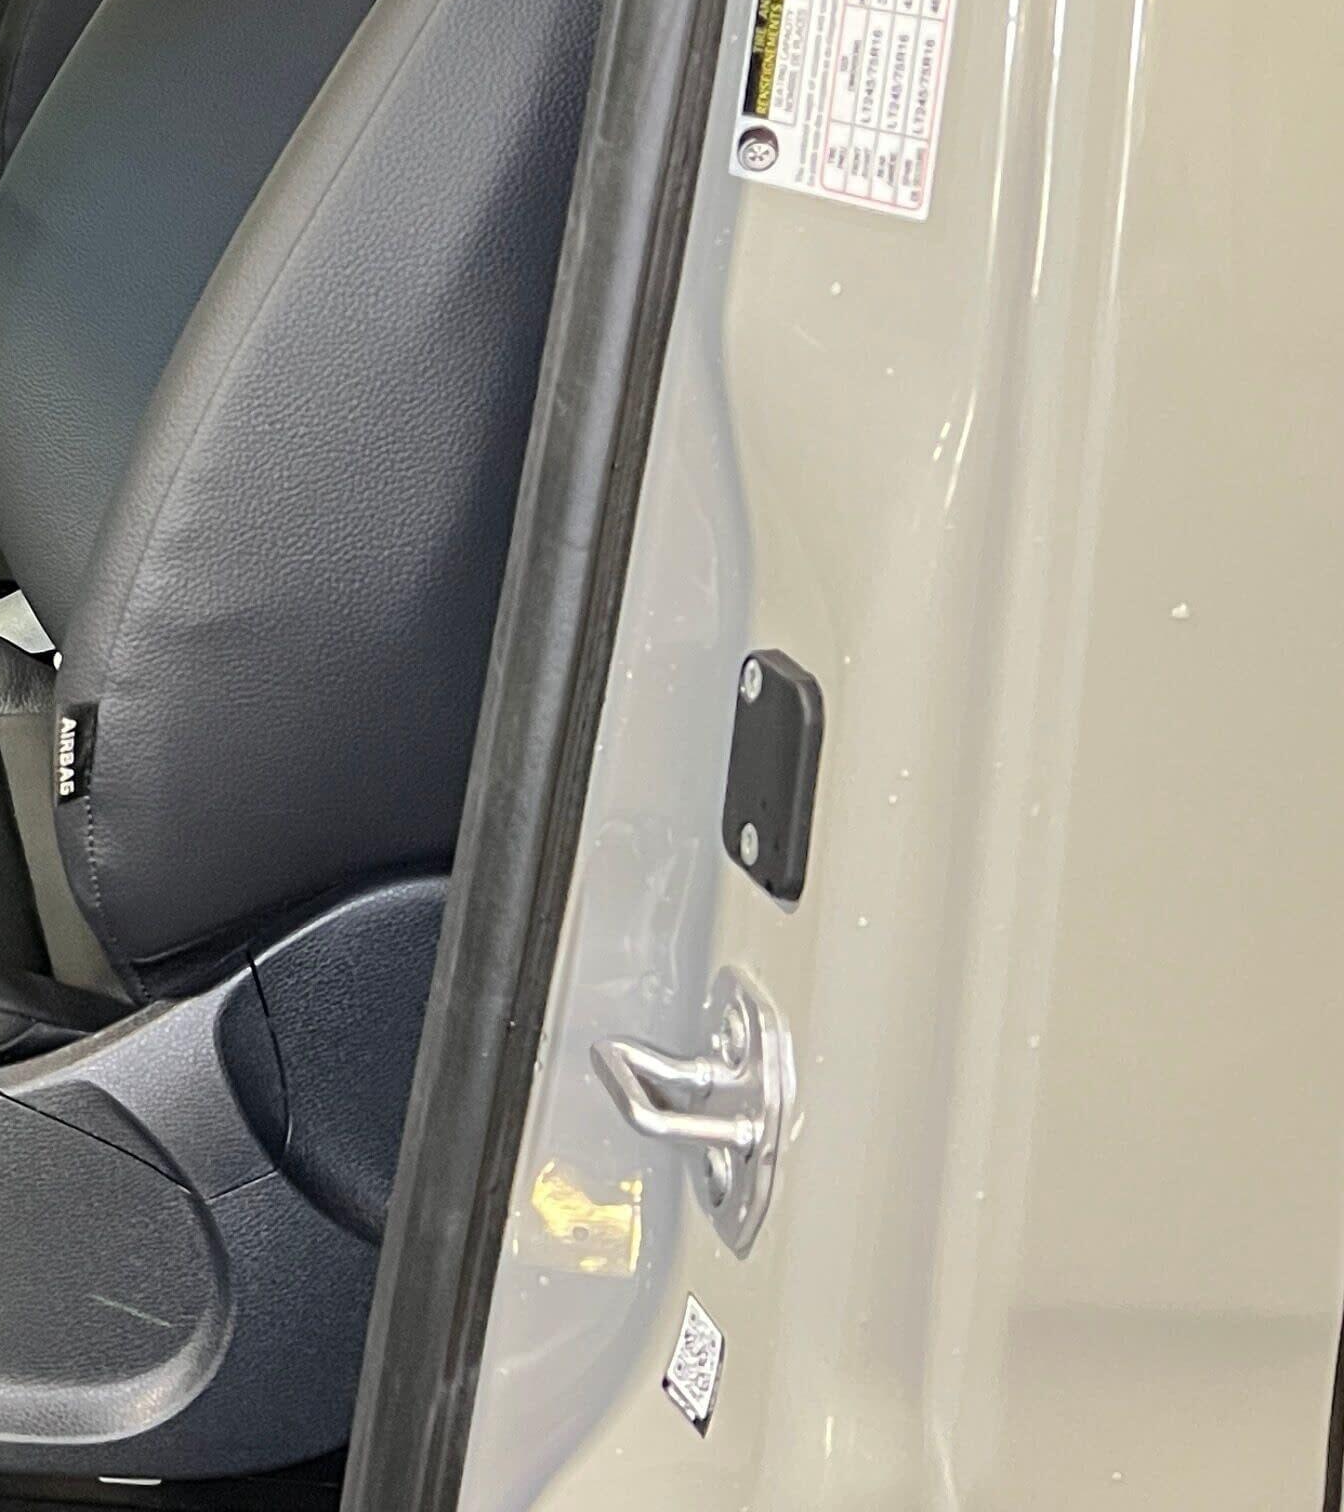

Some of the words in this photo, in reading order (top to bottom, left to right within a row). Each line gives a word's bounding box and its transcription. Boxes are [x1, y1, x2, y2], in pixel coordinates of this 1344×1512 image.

[753, 26, 766, 53] TIRE
[755, 3, 782, 114] RENSEIGNEMENTS
[59, 717, 77, 796] AIRBAG
